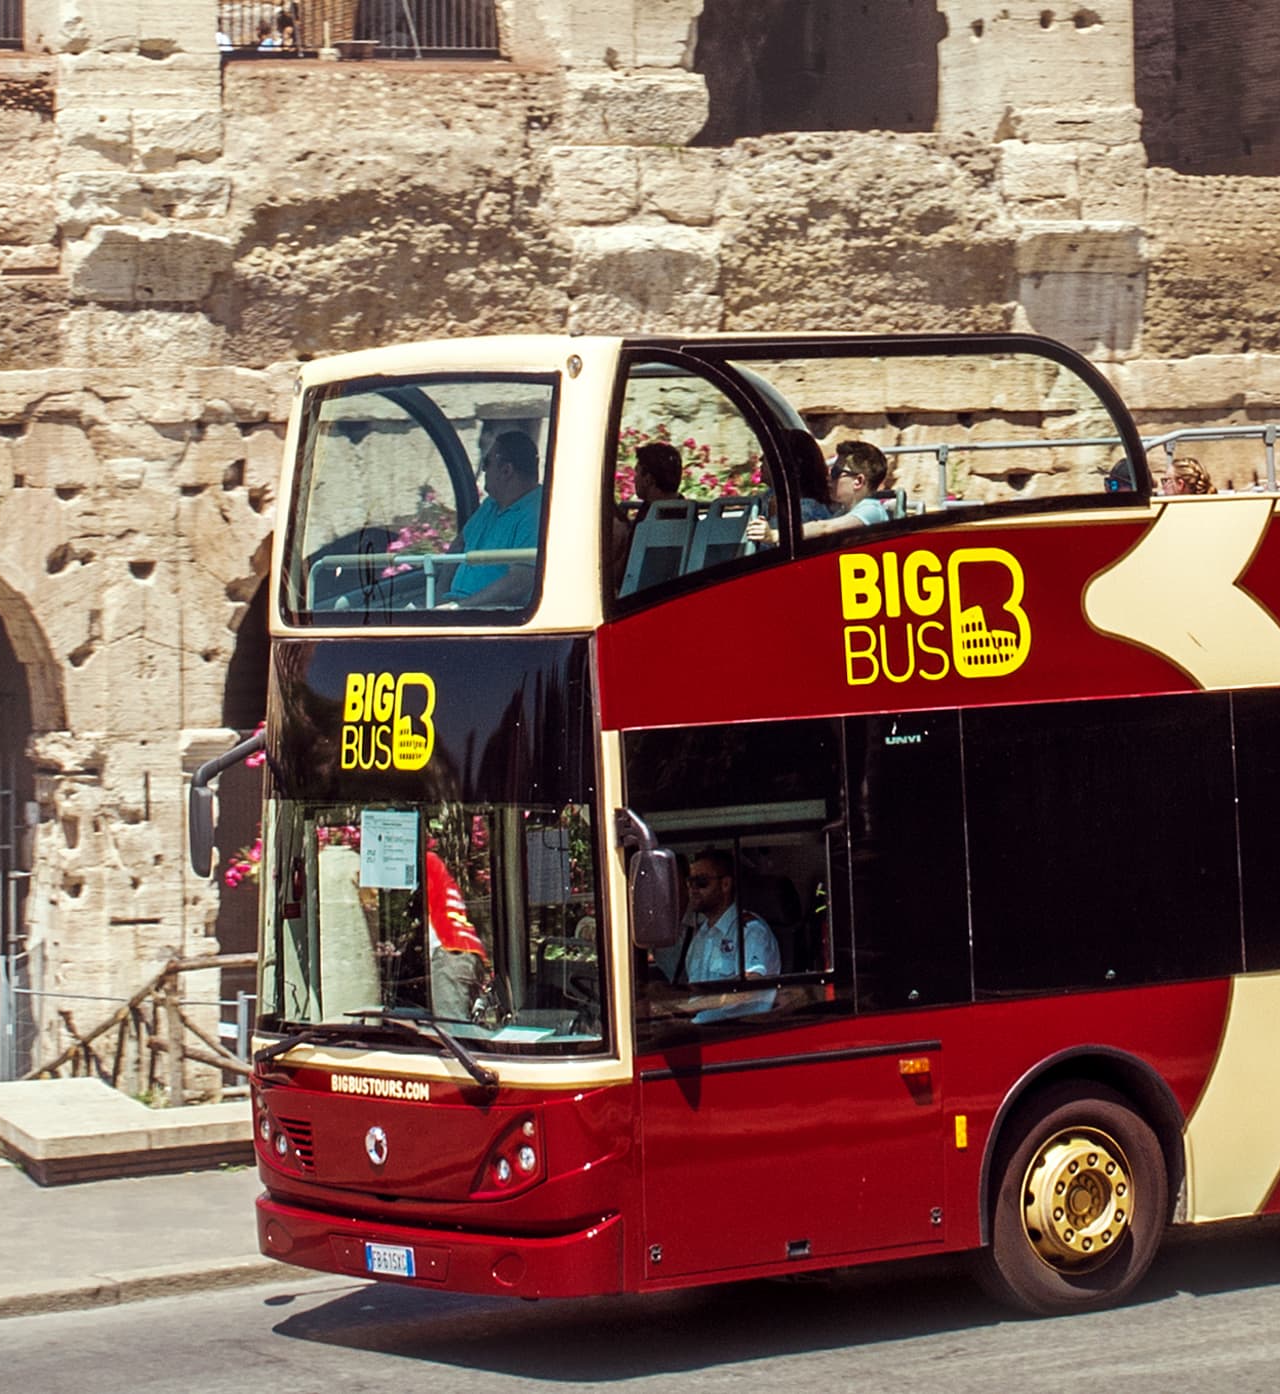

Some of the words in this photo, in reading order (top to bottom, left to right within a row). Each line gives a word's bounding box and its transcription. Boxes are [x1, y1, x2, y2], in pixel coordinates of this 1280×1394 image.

[839, 550, 945, 620] BIG
[844, 621, 950, 685] BUS
[343, 672, 395, 722] BIG
[341, 725, 392, 770] BUS
[331, 1074, 430, 1101] BIGBUSTOURS.COM
